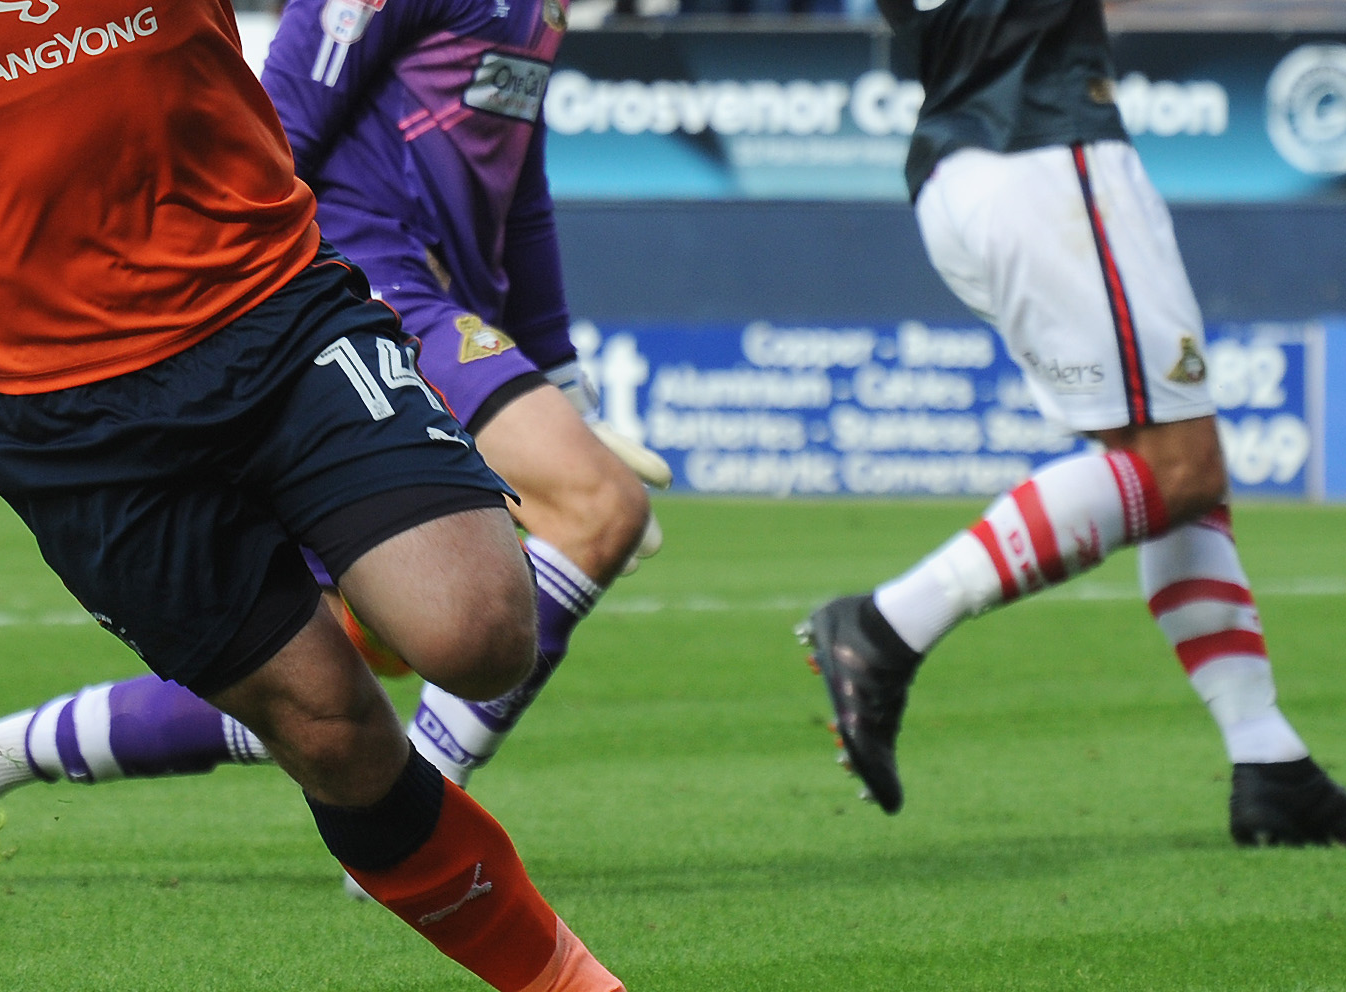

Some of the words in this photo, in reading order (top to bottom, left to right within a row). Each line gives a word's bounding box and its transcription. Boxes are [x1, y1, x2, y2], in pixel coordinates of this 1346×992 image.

[544, 69, 850, 135] Grosvenor
[1114, 71, 1229, 137] ton
[741, 322, 877, 370] Copper
[897, 321, 995, 369] Brass
[314, 336, 445, 422] 14
[685, 448, 842, 498] Catalytic
[842, 448, 1033, 495] Converters
